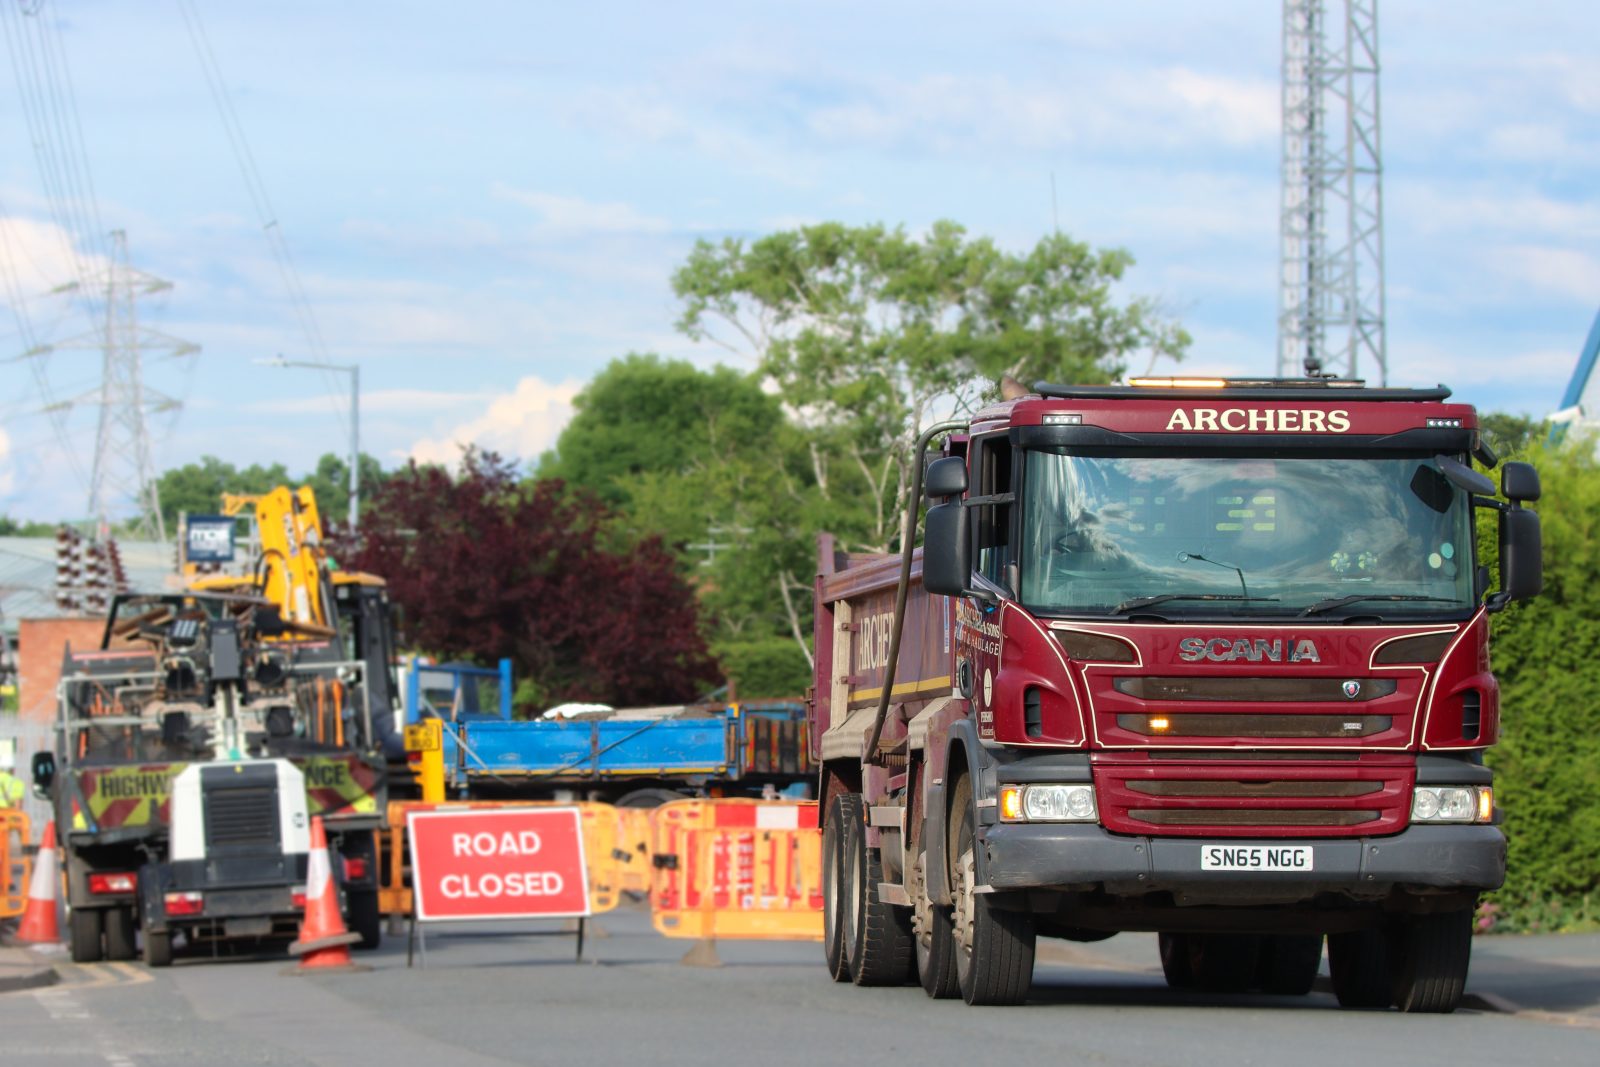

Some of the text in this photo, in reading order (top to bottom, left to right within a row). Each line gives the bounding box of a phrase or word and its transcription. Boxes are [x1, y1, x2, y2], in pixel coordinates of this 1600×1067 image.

[1166, 408, 1351, 433] ARCHERS
[1179, 637, 1321, 662] SCANIA
[452, 831, 541, 857] ROAD
[1210, 848, 1304, 867] SN65 NGG
[440, 871, 563, 899] CLOSED
